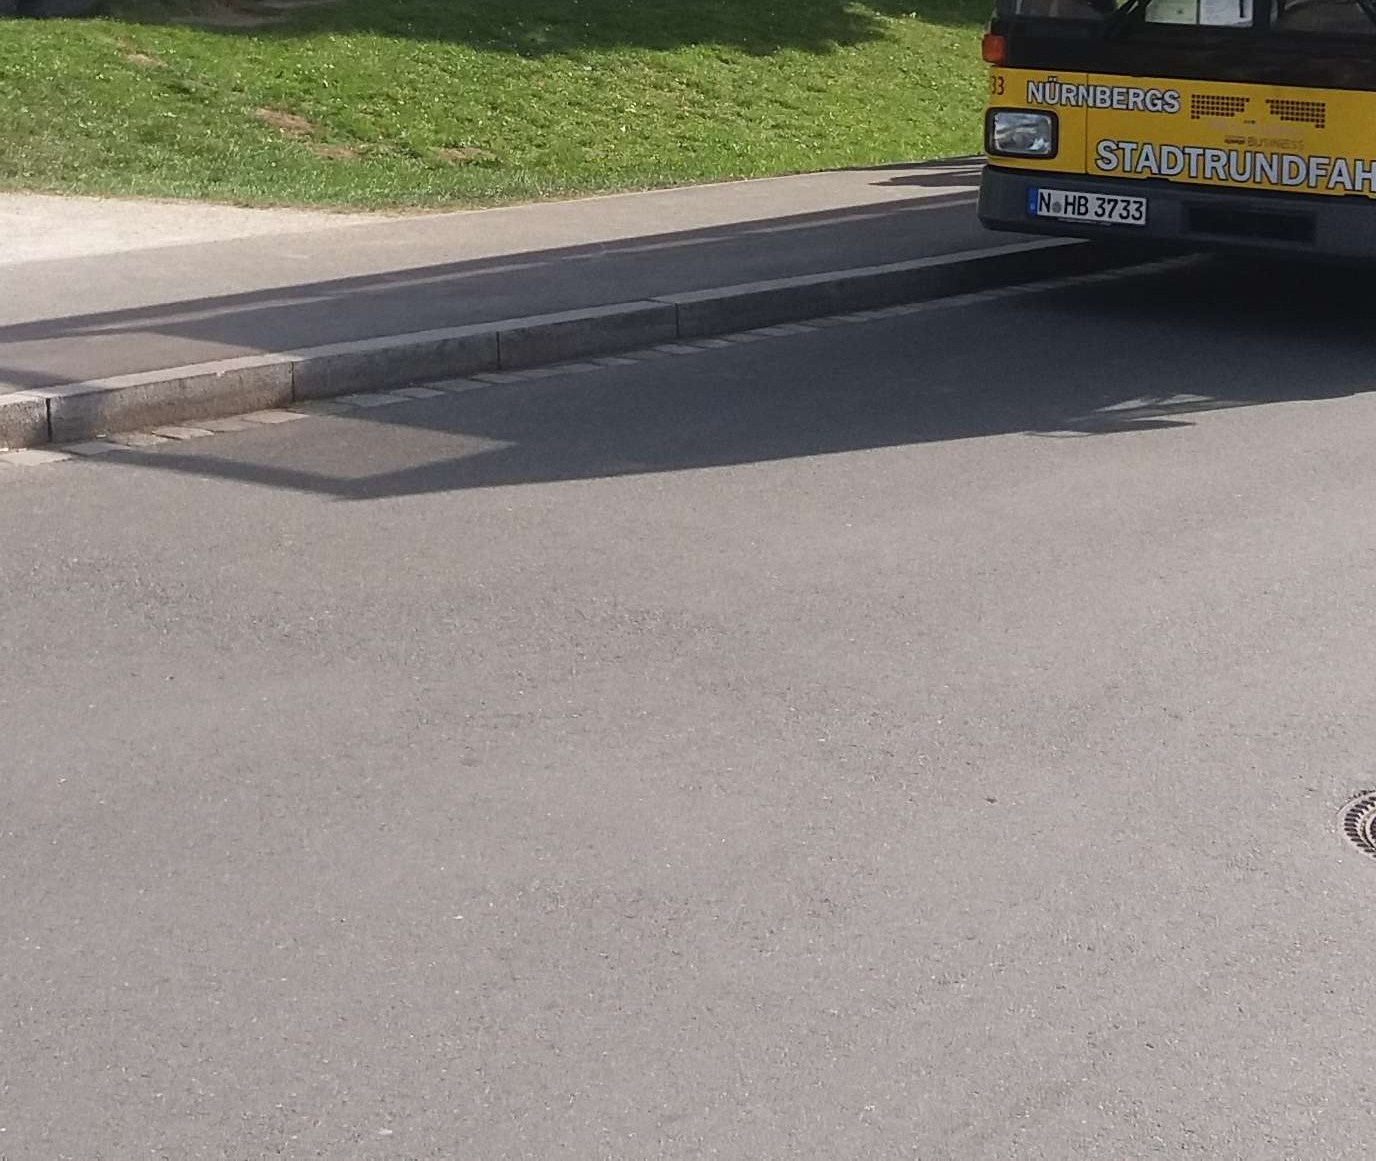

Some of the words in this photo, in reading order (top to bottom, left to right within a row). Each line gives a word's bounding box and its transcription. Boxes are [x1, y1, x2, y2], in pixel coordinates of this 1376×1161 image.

[1027, 75, 1181, 114] NÜRNBERGS
[1039, 192, 1051, 214] N
[1064, 195, 1089, 217] HB
[1094, 197, 1144, 222] 3733
